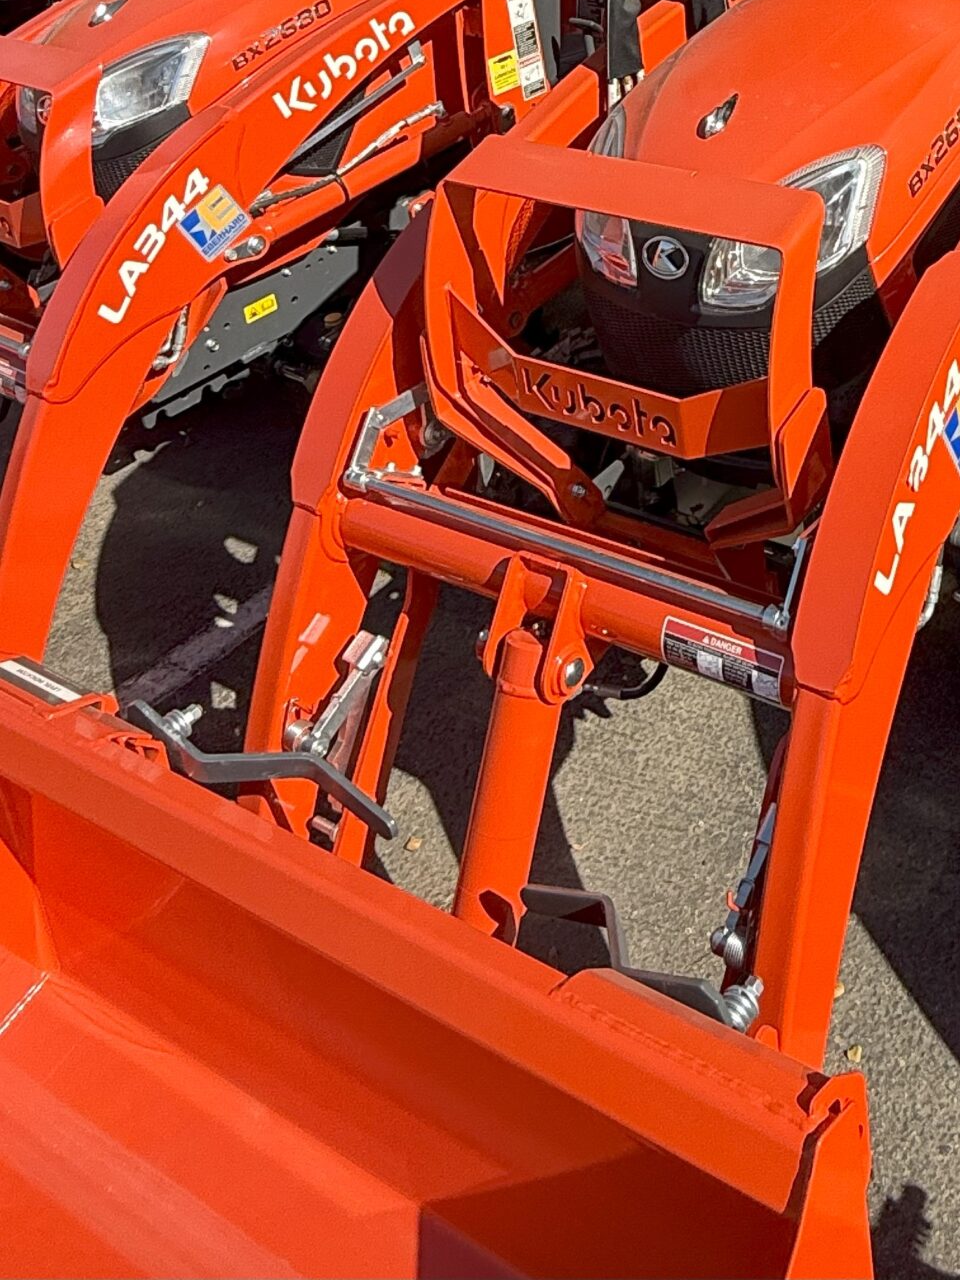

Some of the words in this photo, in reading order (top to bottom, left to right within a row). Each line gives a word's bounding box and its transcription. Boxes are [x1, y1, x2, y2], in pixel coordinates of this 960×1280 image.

[271, 10, 416, 120] Kubota
[97, 167, 210, 324] LA344
[202, 213, 246, 257] EBERHARD
[521, 366, 678, 449] Kubota
[711, 635, 743, 655] DANGER
